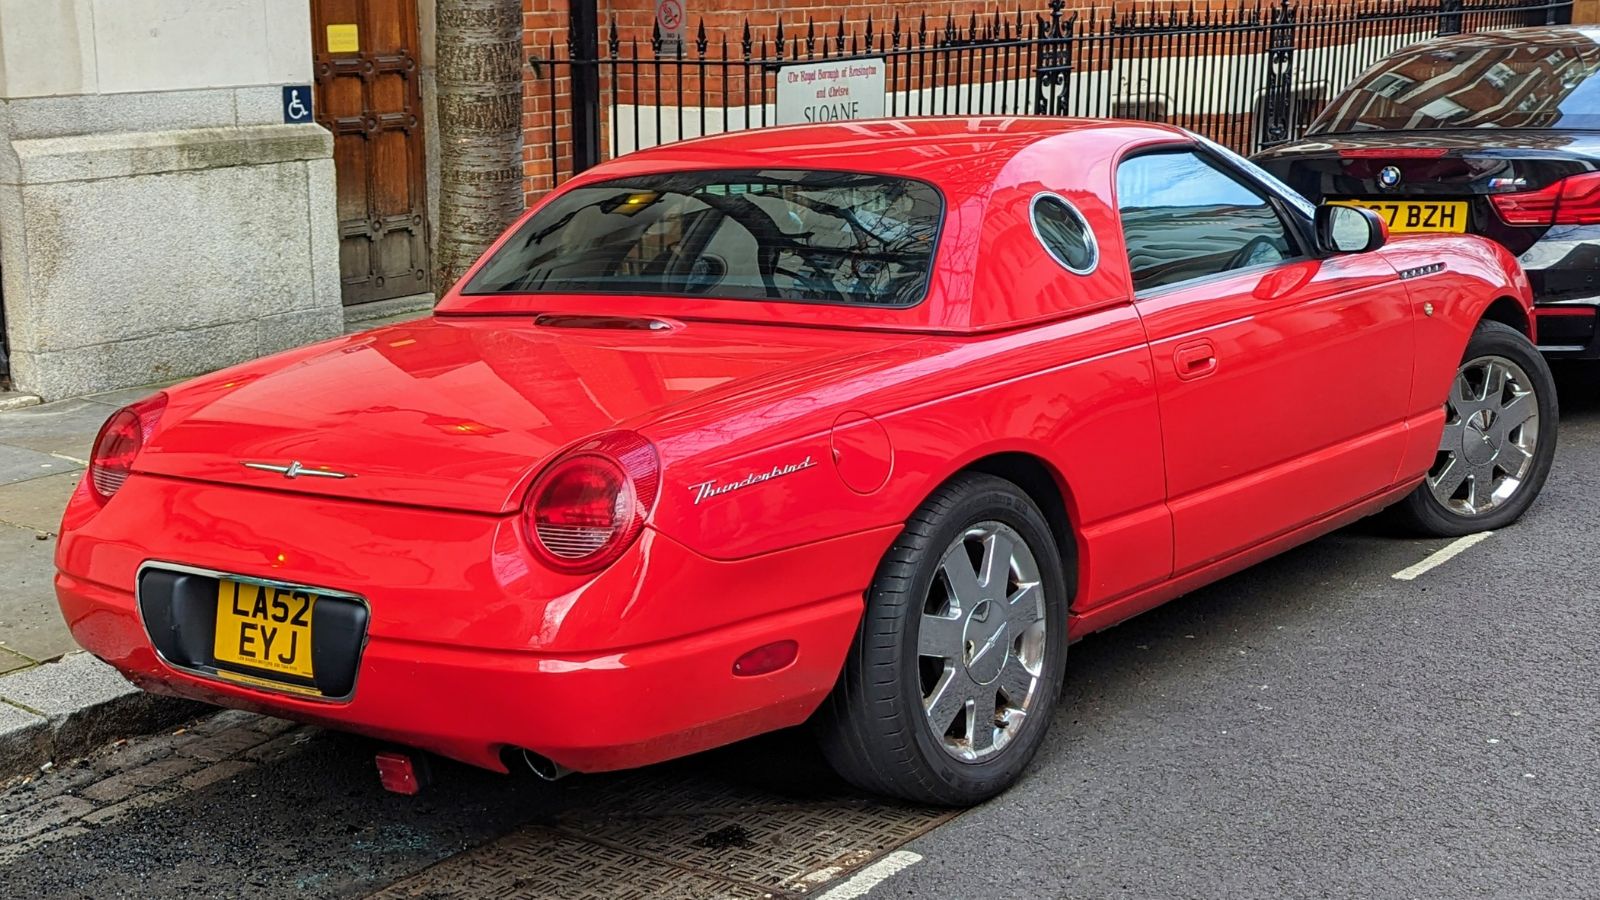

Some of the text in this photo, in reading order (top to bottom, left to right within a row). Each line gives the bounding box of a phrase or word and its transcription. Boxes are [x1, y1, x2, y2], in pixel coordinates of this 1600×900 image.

[788, 65, 877, 84] The Royal Borough of Kensington
[816, 86, 849, 98] and Chelsea
[804, 102, 859, 122] SLOANE
[1406, 204, 1456, 228] BZH
[688, 456, 817, 504] Thunderbird
[233, 582, 310, 627] LA52
[239, 621, 297, 665] EYJ
